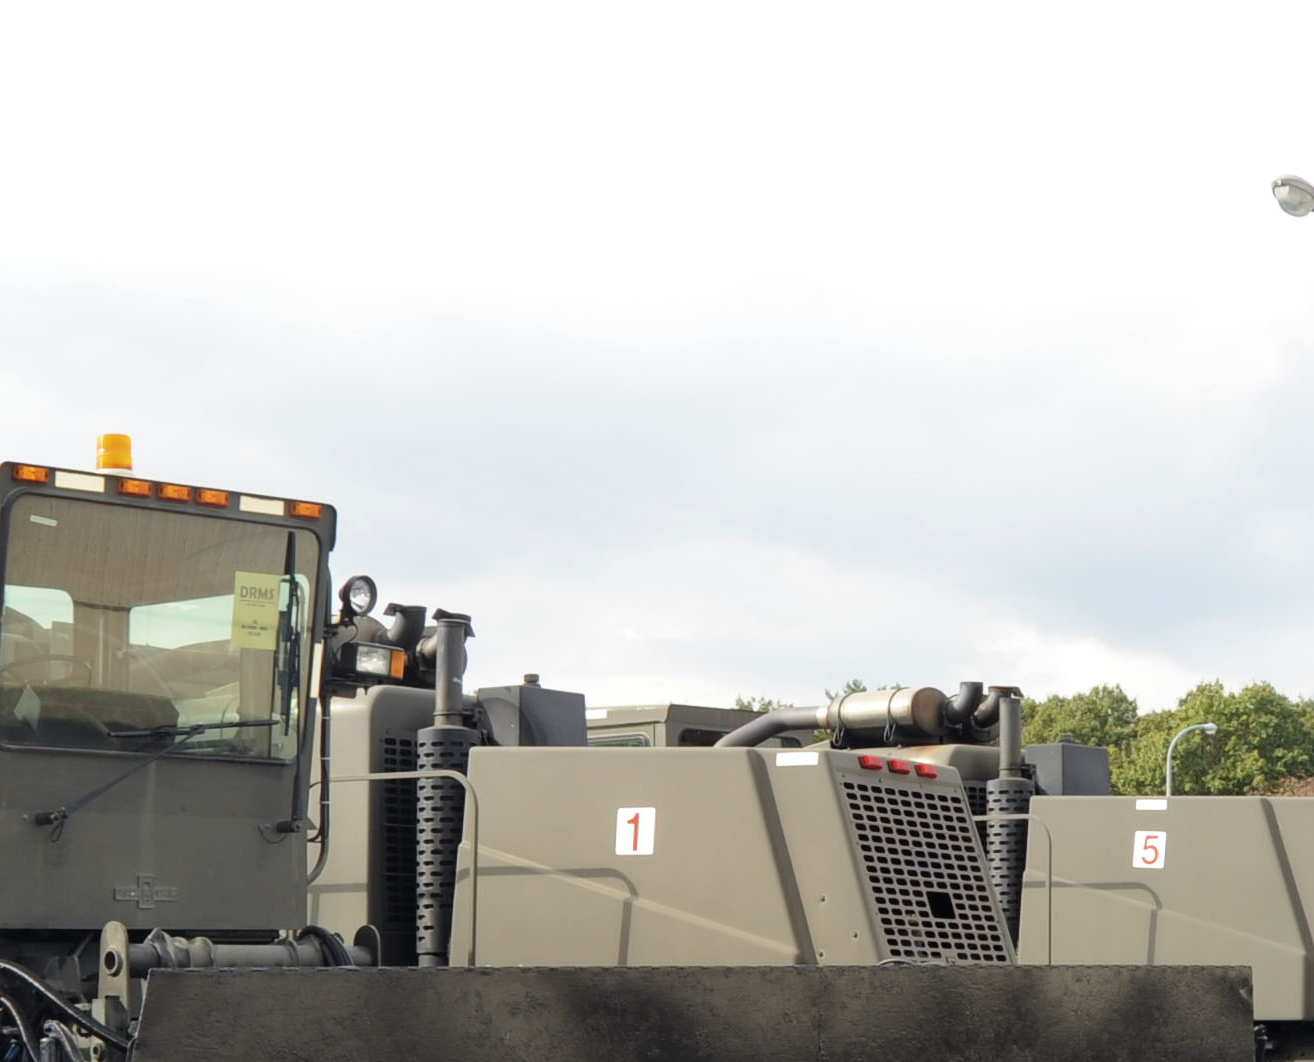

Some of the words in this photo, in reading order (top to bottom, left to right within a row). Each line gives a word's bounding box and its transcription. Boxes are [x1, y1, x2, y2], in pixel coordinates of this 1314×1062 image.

[240, 585, 275, 601] DRMS
[627, 812, 640, 852] 1
[1142, 835, 1159, 865] 5
